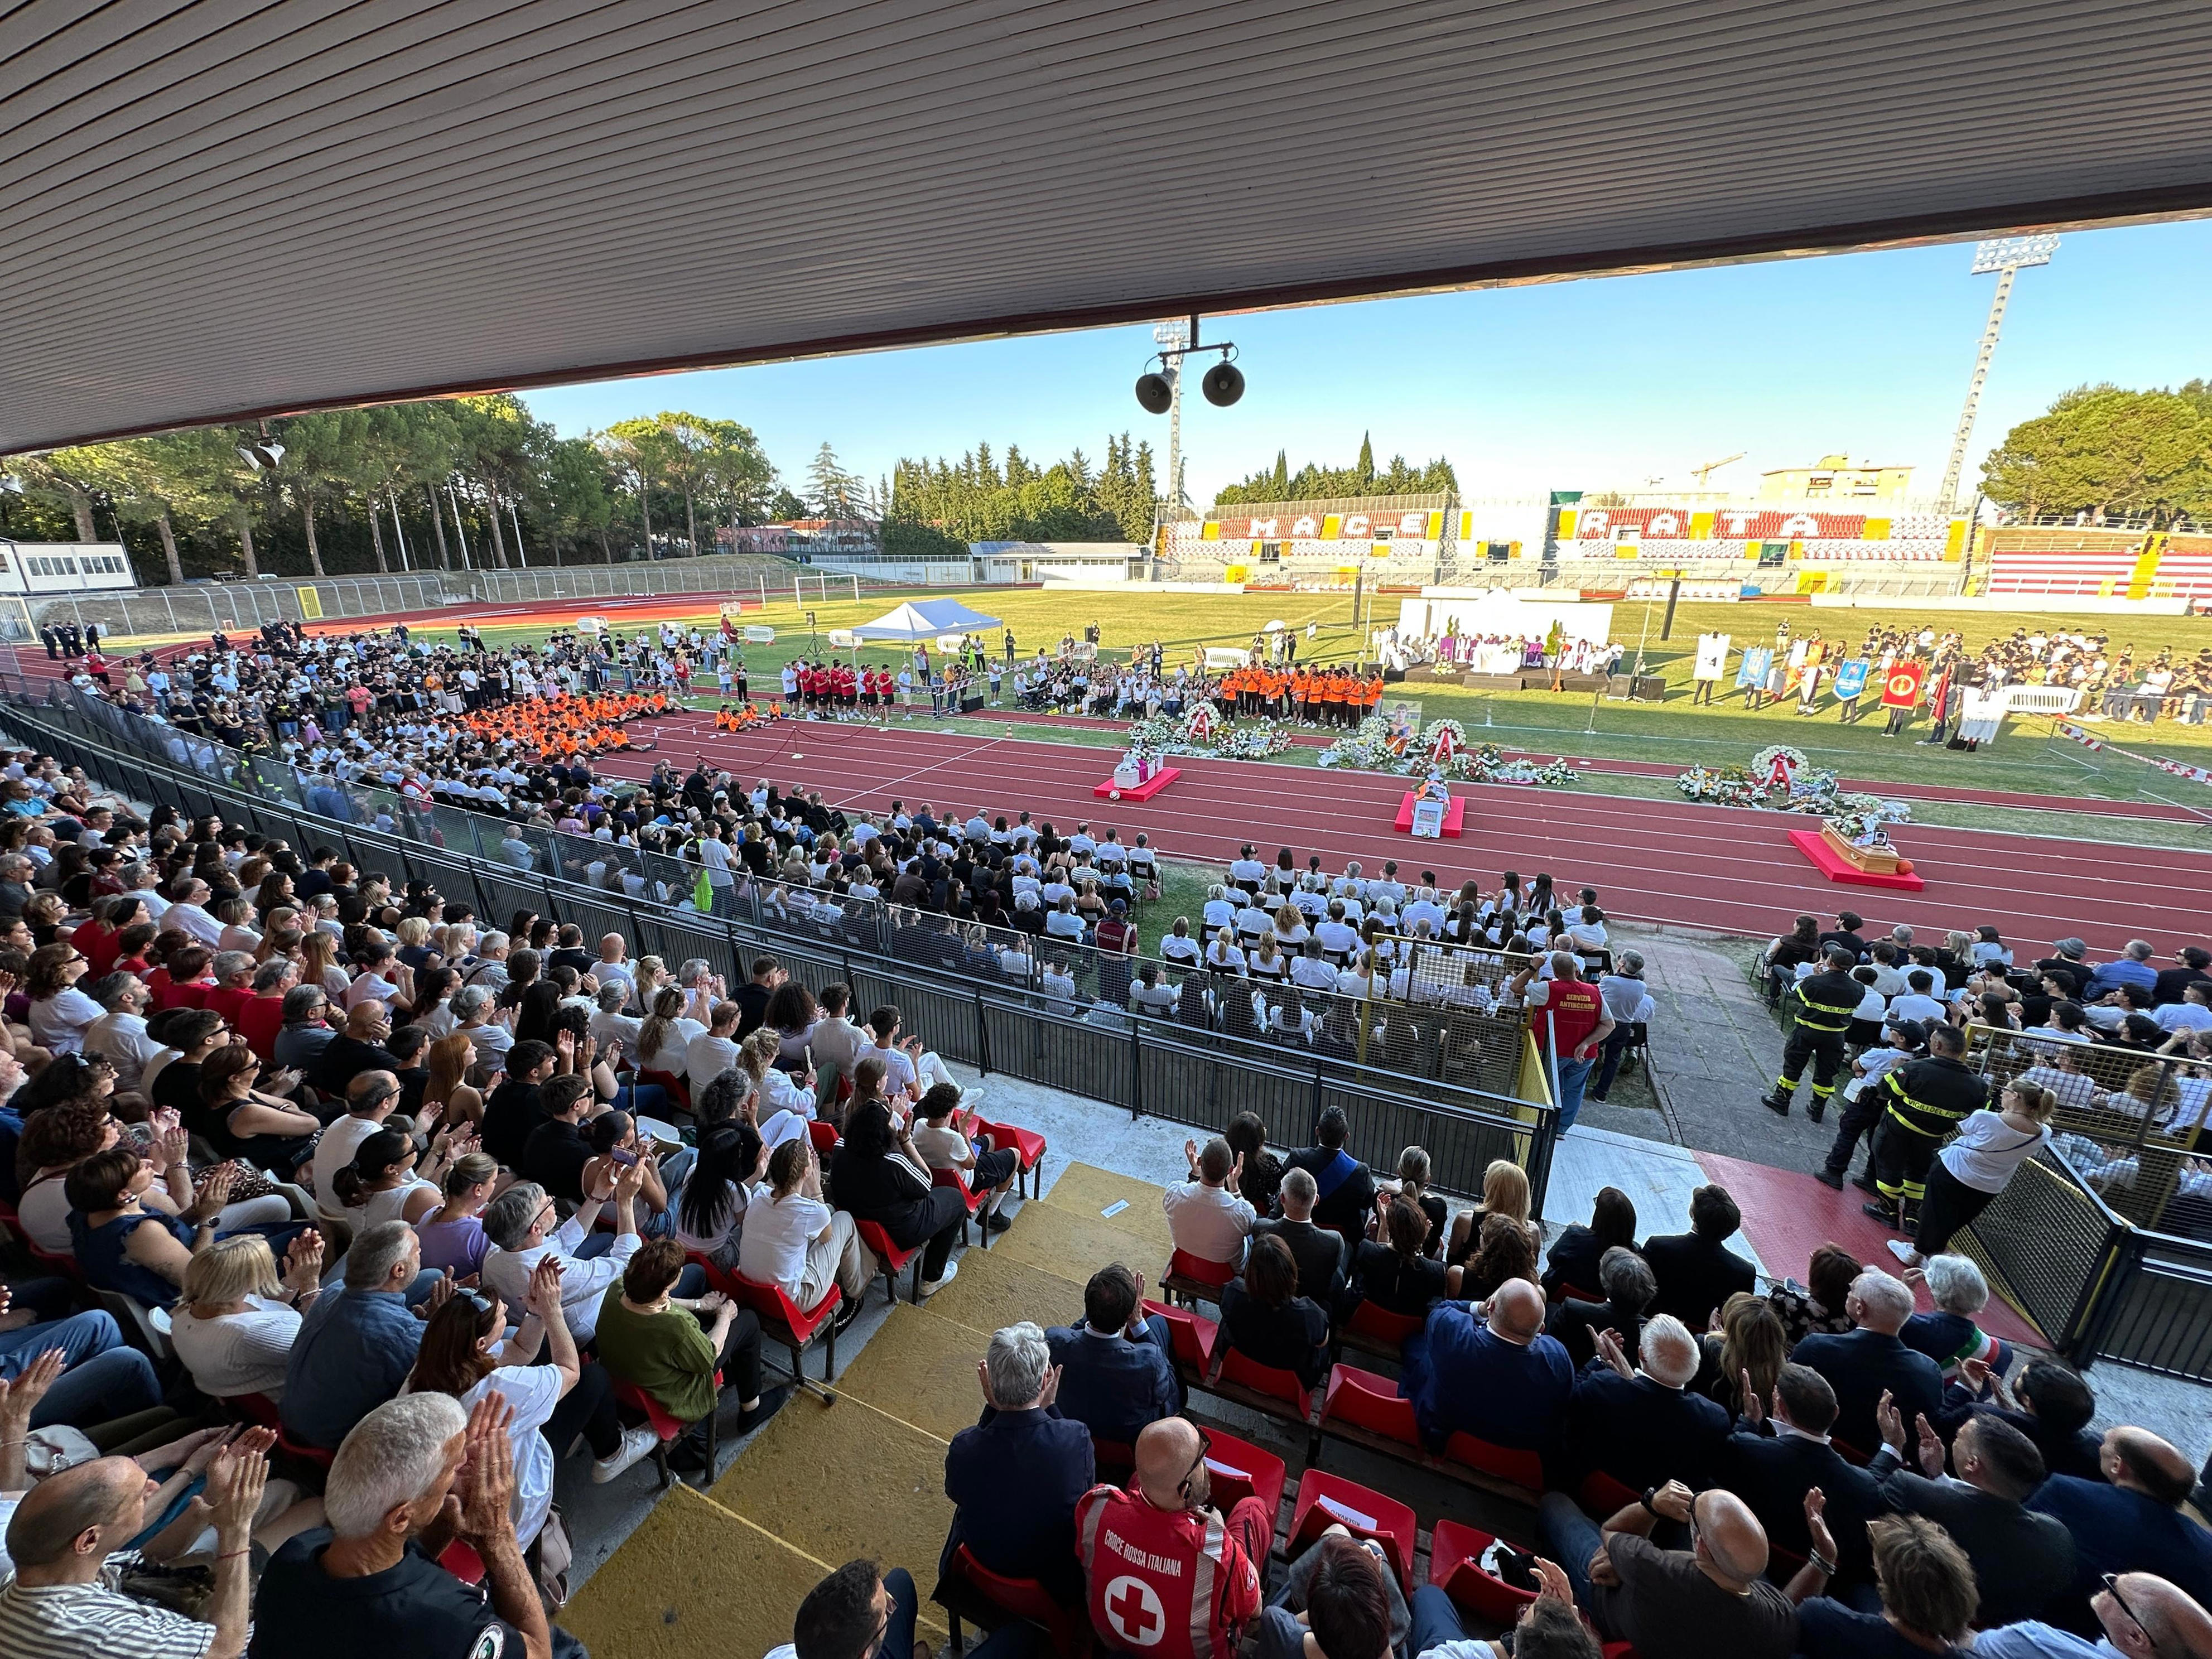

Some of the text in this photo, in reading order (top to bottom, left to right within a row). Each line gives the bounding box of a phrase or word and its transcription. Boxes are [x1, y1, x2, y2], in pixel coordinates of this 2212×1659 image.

[1566, 994, 1591, 1002] SERVIZIO
[1908, 1099, 1930, 1112] VIGILI
[1105, 1529, 1182, 1578] CROCE ROSSA ITALIANA
